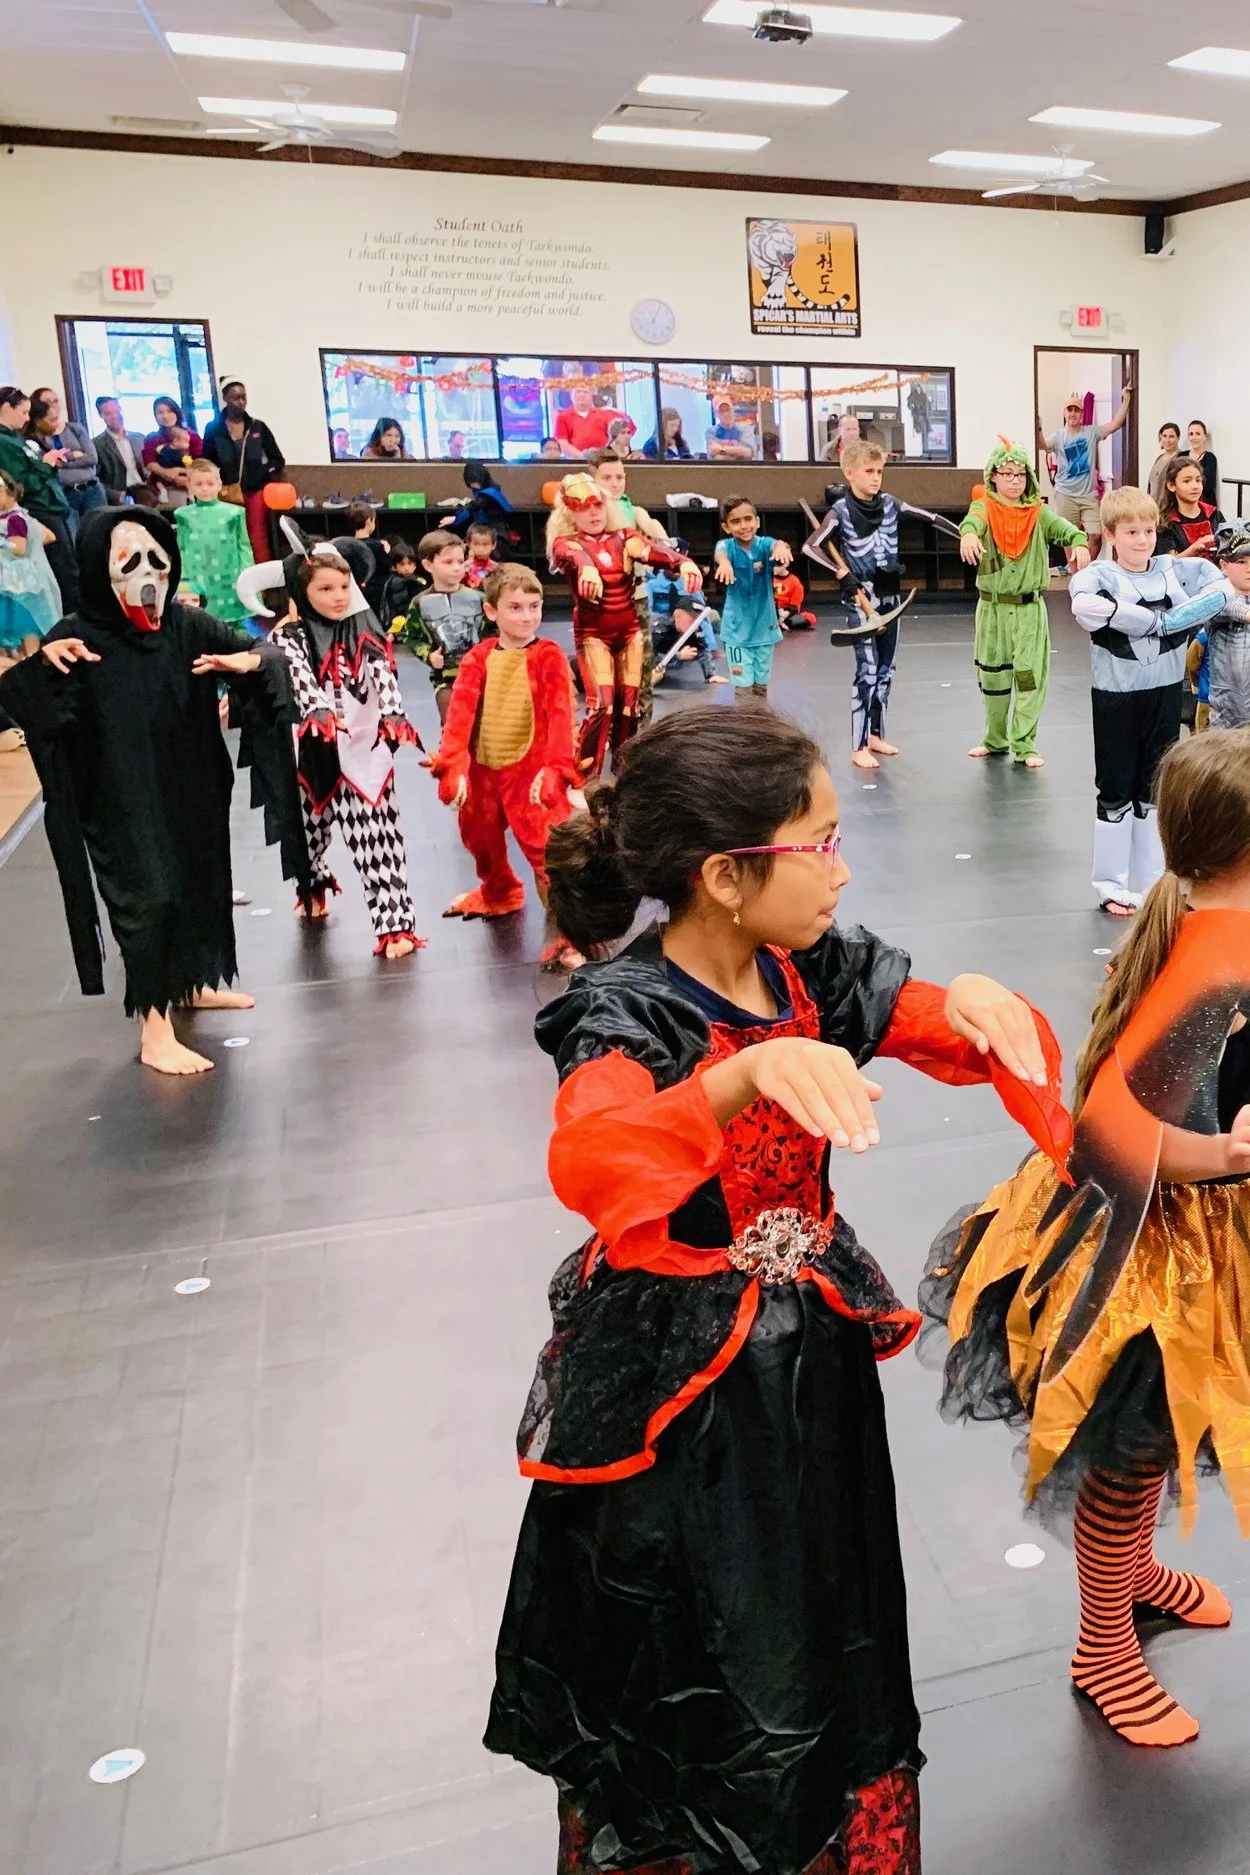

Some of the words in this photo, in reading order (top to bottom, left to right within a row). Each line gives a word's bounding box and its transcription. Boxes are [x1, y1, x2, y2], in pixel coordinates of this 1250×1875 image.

[434, 217, 486, 232] Student
[491, 220, 523, 233] Oath
[363, 232, 368, 243] I
[373, 231, 403, 245] shall
[405, 233, 447, 247] observe
[452, 235, 470, 247] the
[473, 239, 508, 249] tenets
[511, 238, 525, 253] of
[526, 239, 594, 254] Taekwondo.
[348, 248, 353, 259] I
[357, 247, 387, 260] shall
[390, 252, 429, 265] respect
[434, 252, 496, 265] instructors
[499, 255, 521, 267] and
[525, 257, 558, 268] senior
[561, 257, 610, 270] students.
[112, 267, 145, 292] EXIT
[390, 266, 395, 277] I
[400, 265, 429, 278] shall
[431, 270, 462, 279] never
[466, 272, 501, 281] misuse
[505, 271, 575, 285] Taekwondo.
[358, 281, 363, 292] I
[368, 281, 393, 294] will
[395, 282, 408, 294] be
[411, 285, 418, 294] a
[422, 283, 477, 299] champion
[481, 286, 495, 301] of
[495, 285, 541, 301] freedom
[544, 288, 566, 300] and
[568, 292, 607, 304] justice.
[386, 299, 391, 310] I
[396, 299, 421, 311] will
[423, 299, 453, 312] build
[456, 304, 463, 312] a
[467, 304, 493, 313] more
[497, 303, 545, 317] peaceful
[548, 305, 583, 317] world.
[796, 310, 834, 324] MARTIAL
[834, 312, 858, 325] ARTS
[1078, 307, 1101, 328] EXIT
[729, 646, 742, 663] 10
